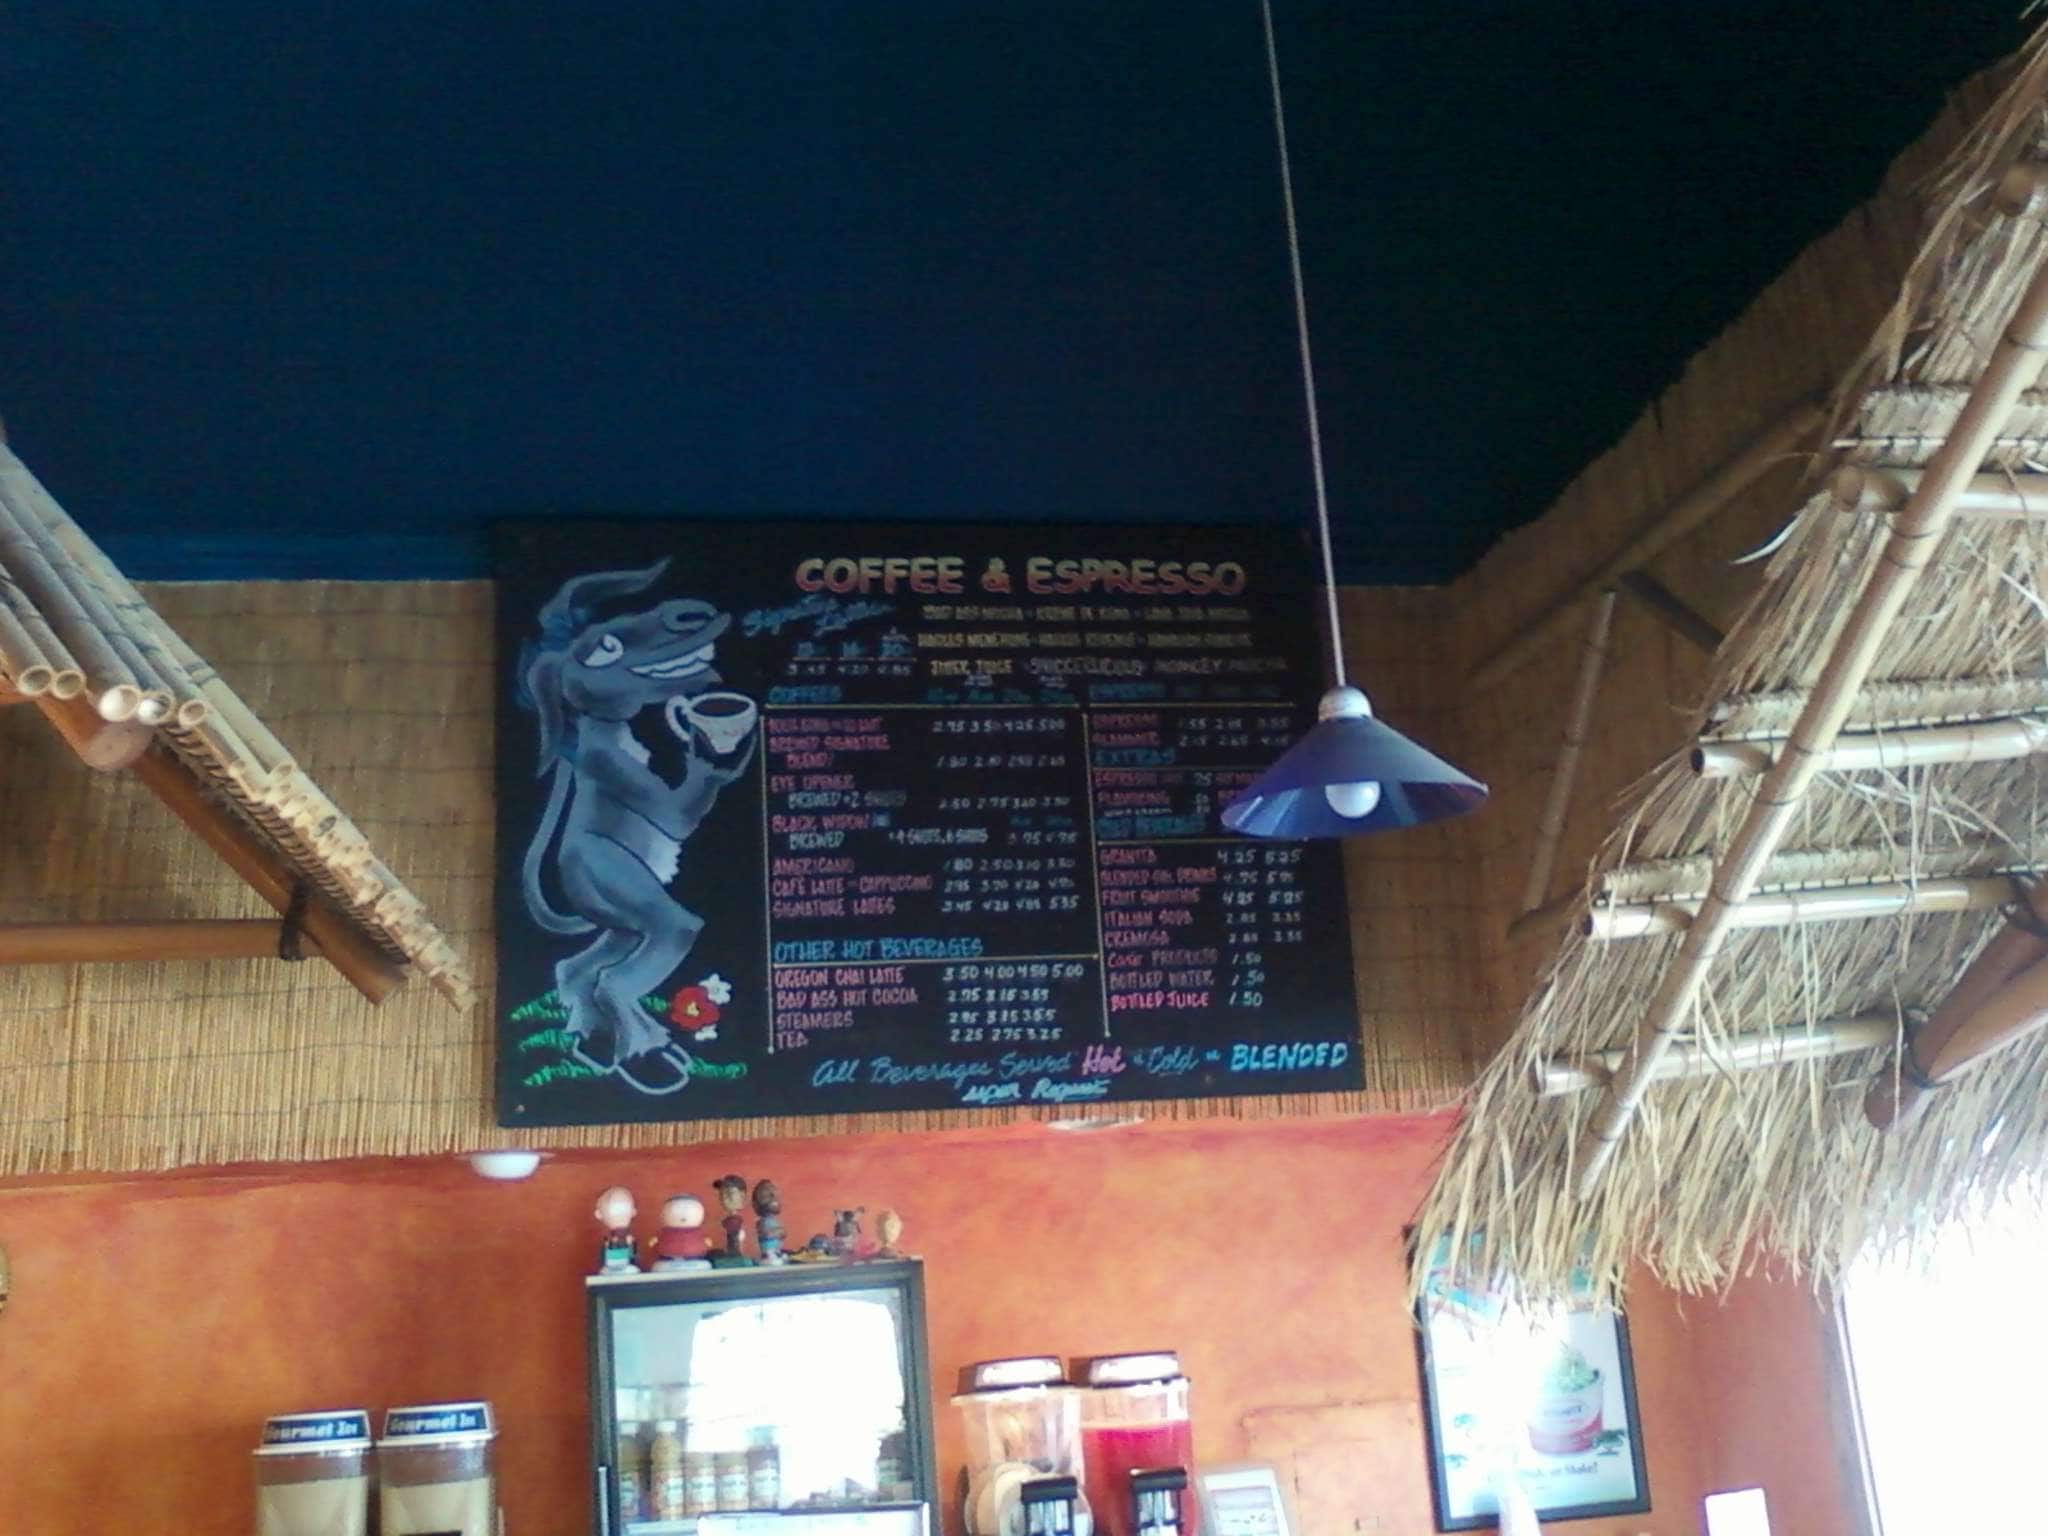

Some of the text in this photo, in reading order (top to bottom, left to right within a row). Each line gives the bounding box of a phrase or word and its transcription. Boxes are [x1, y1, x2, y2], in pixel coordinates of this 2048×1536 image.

[796, 556, 1247, 596] COFFEE & ESPRESSO
[774, 936, 984, 964] OTHER HOT BEVERAGES
[774, 968, 829, 989] OREGON
[868, 964, 906, 985] LATTE
[776, 987, 919, 1010] BAD ASS HOT COCOA
[1110, 993, 1165, 1012] BOTTLED
[1167, 991, 1209, 1009] JUICE
[775, 1011, 854, 1031] STEAMERS
[776, 1031, 809, 1050] TEA
[811, 1059, 861, 1088] All
[869, 1055, 993, 1090] Beverages
[999, 1050, 1074, 1079] Served
[1081, 1044, 1127, 1076] Hot
[1230, 1041, 1349, 1074] BLENDED
